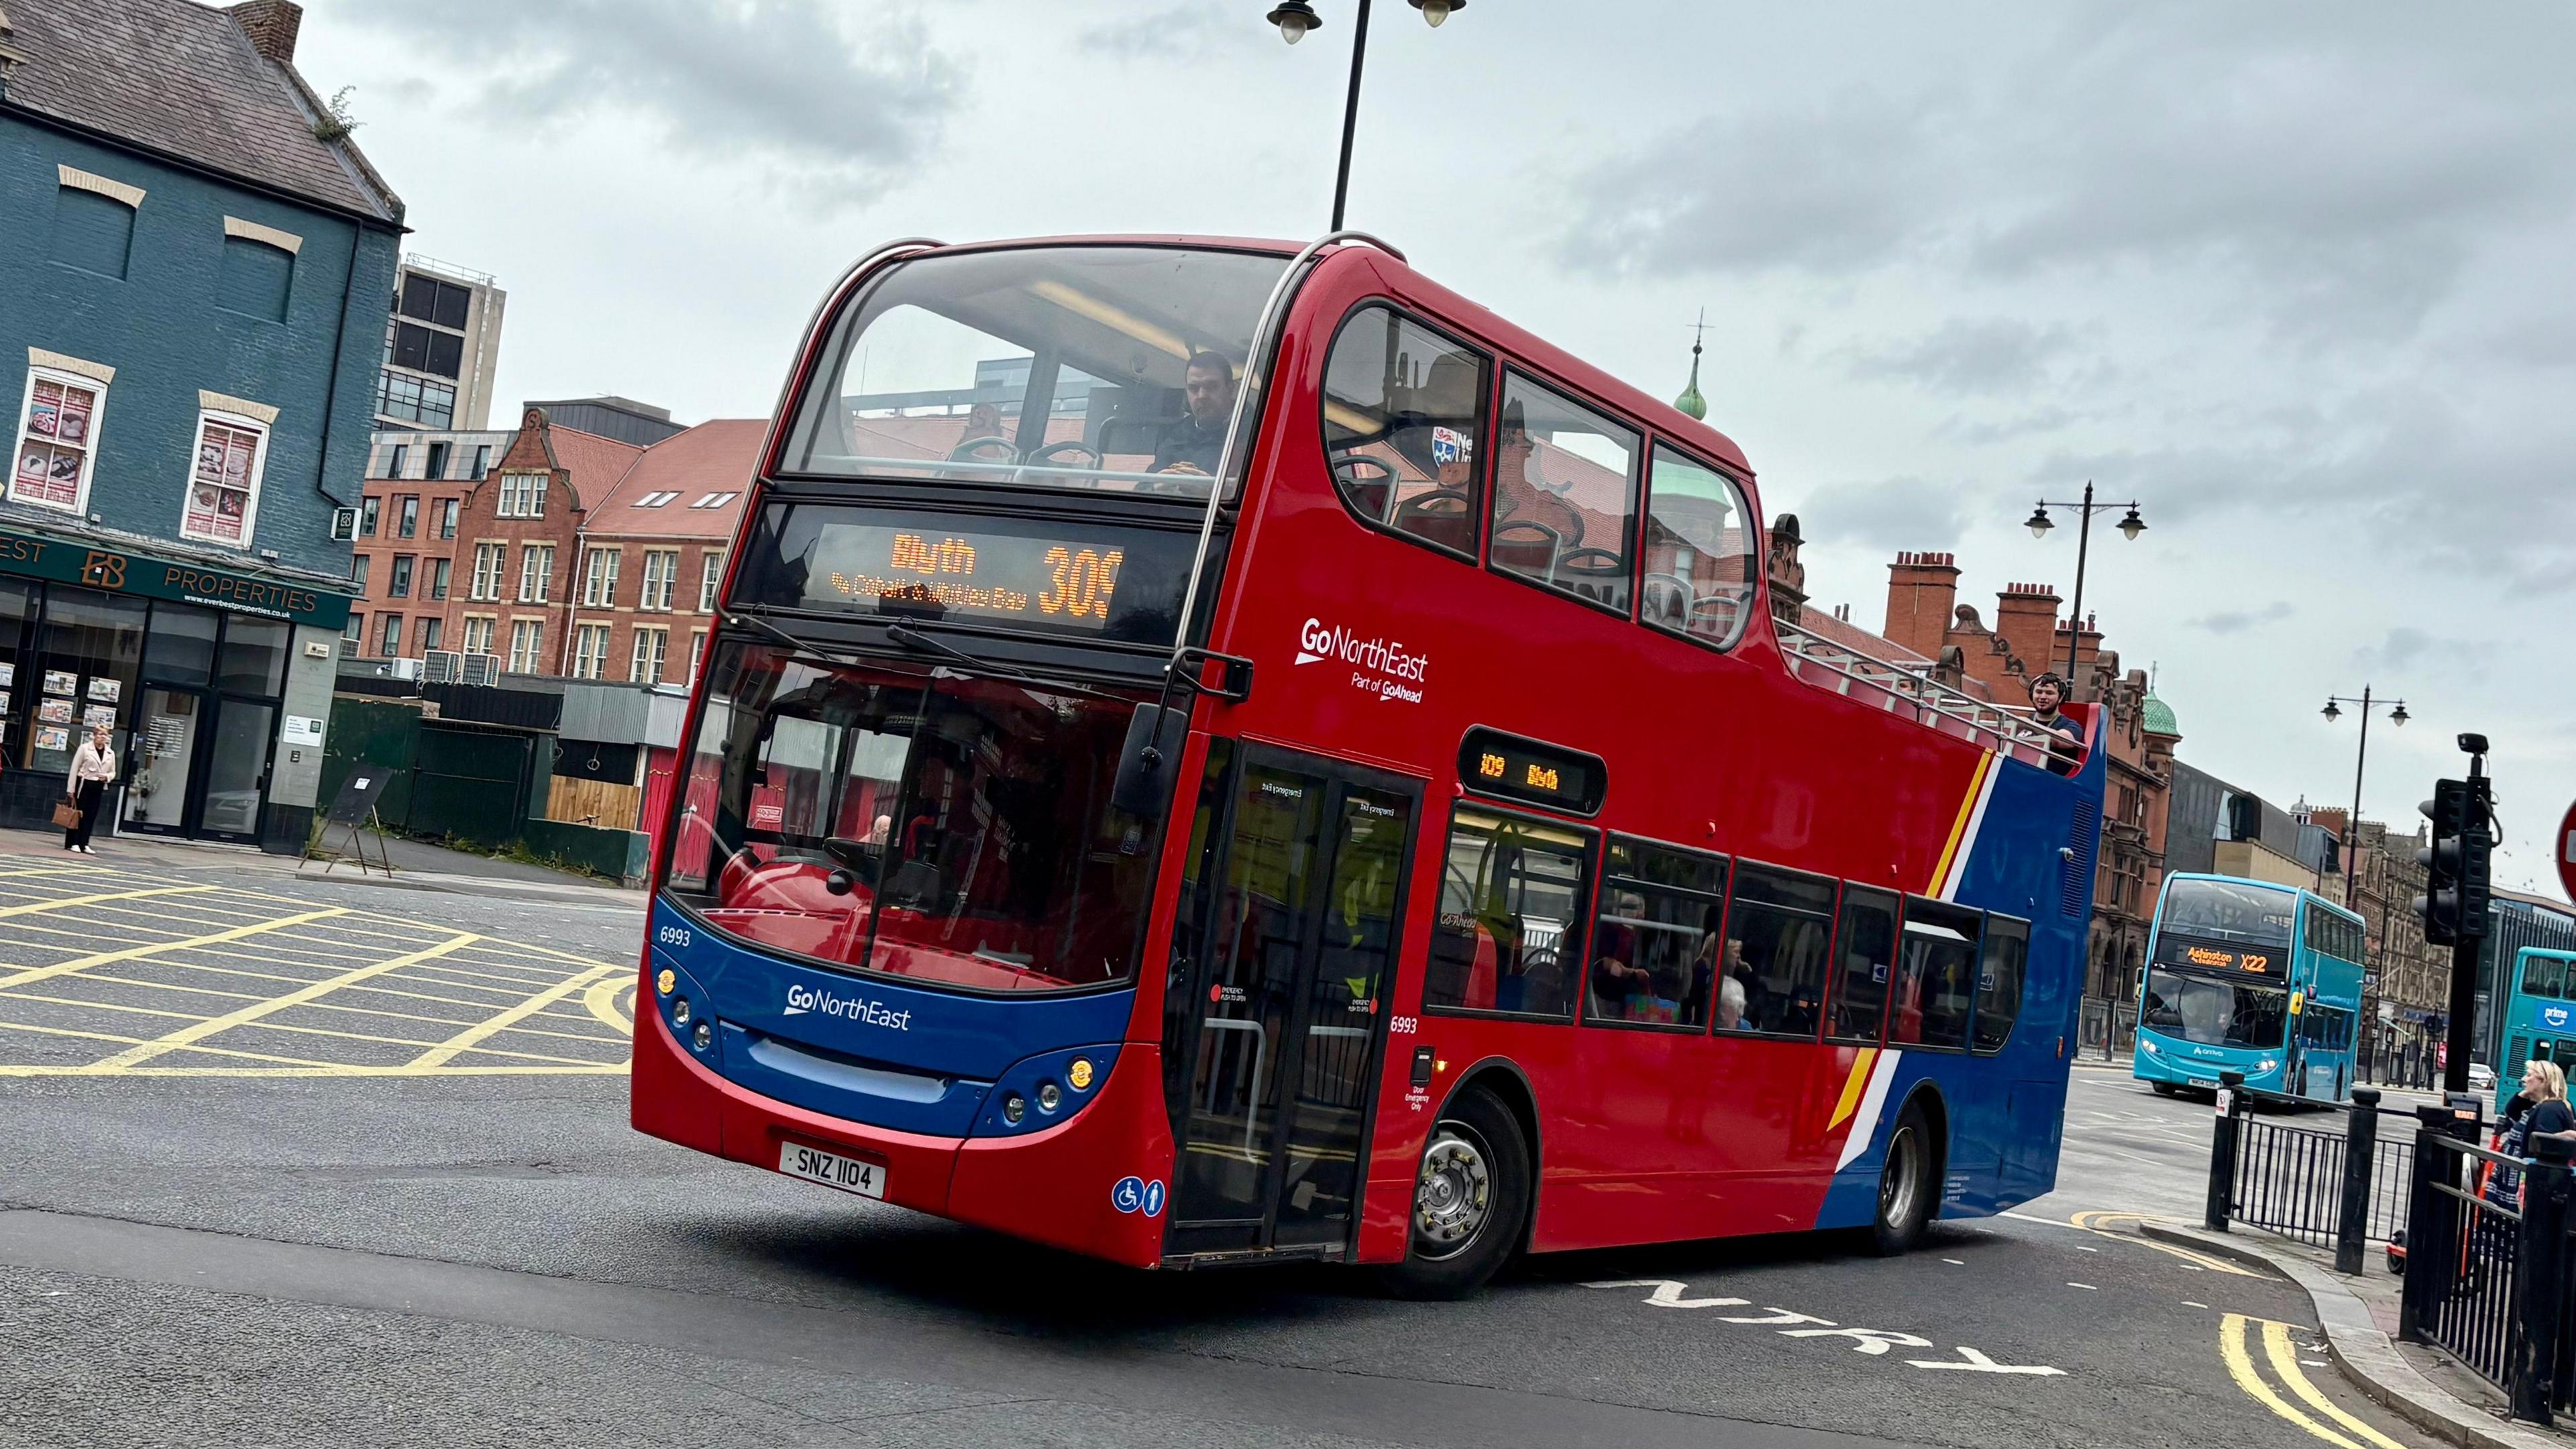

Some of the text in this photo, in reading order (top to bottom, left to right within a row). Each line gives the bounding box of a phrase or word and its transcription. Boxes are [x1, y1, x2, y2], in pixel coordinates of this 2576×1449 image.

[891, 534, 975, 574] Blyth
[164, 568, 317, 612] PROPERTIES
[853, 574, 906, 598] Cobalt
[927, 581, 989, 606] Whitley
[993, 587, 1027, 610] Bay
[184, 594, 290, 619] www.everbestproperties.co.uk
[1351, 672, 1370, 690] Part
[1371, 679, 1381, 692] of
[1527, 764, 1558, 790] Blyth
[660, 926, 690, 947] 6993
[2240, 953, 2267, 972] X22
[2544, 1007, 2568, 1019] prime
[1391, 1016, 1417, 1034] 6993
[1405, 1093, 1430, 1103] Emergency
[798, 1149, 871, 1189] SNZ 1104
